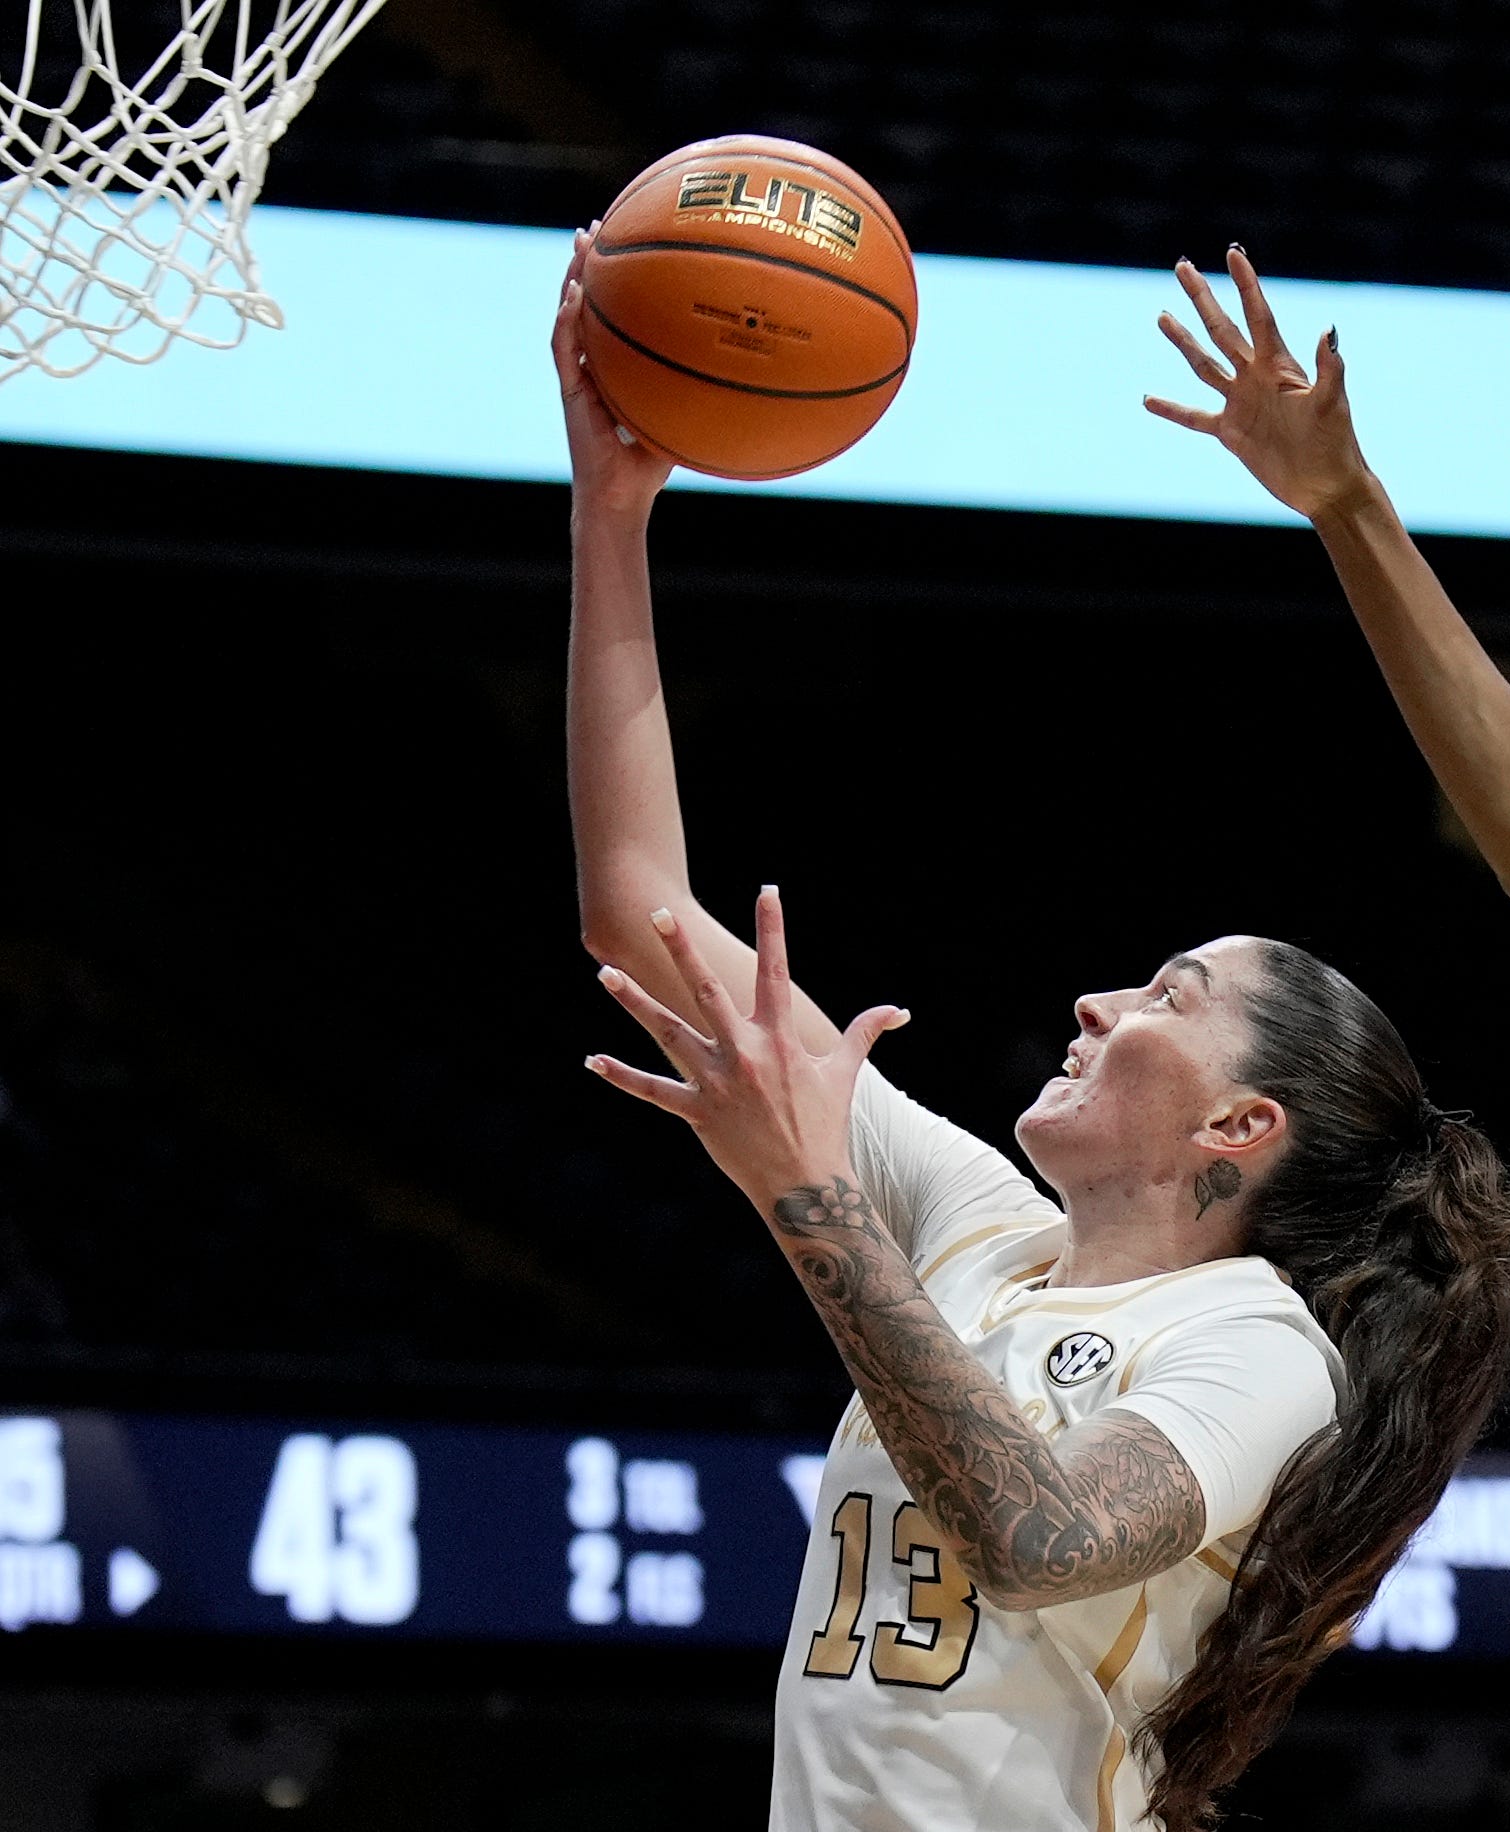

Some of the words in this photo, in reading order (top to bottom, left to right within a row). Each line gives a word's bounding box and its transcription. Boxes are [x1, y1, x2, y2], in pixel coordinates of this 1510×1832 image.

[677, 171, 862, 249] ELITE
[1049, 1333, 1113, 1384] SEC
[251, 1433, 420, 1625] 43
[803, 1492, 978, 1691] 13
